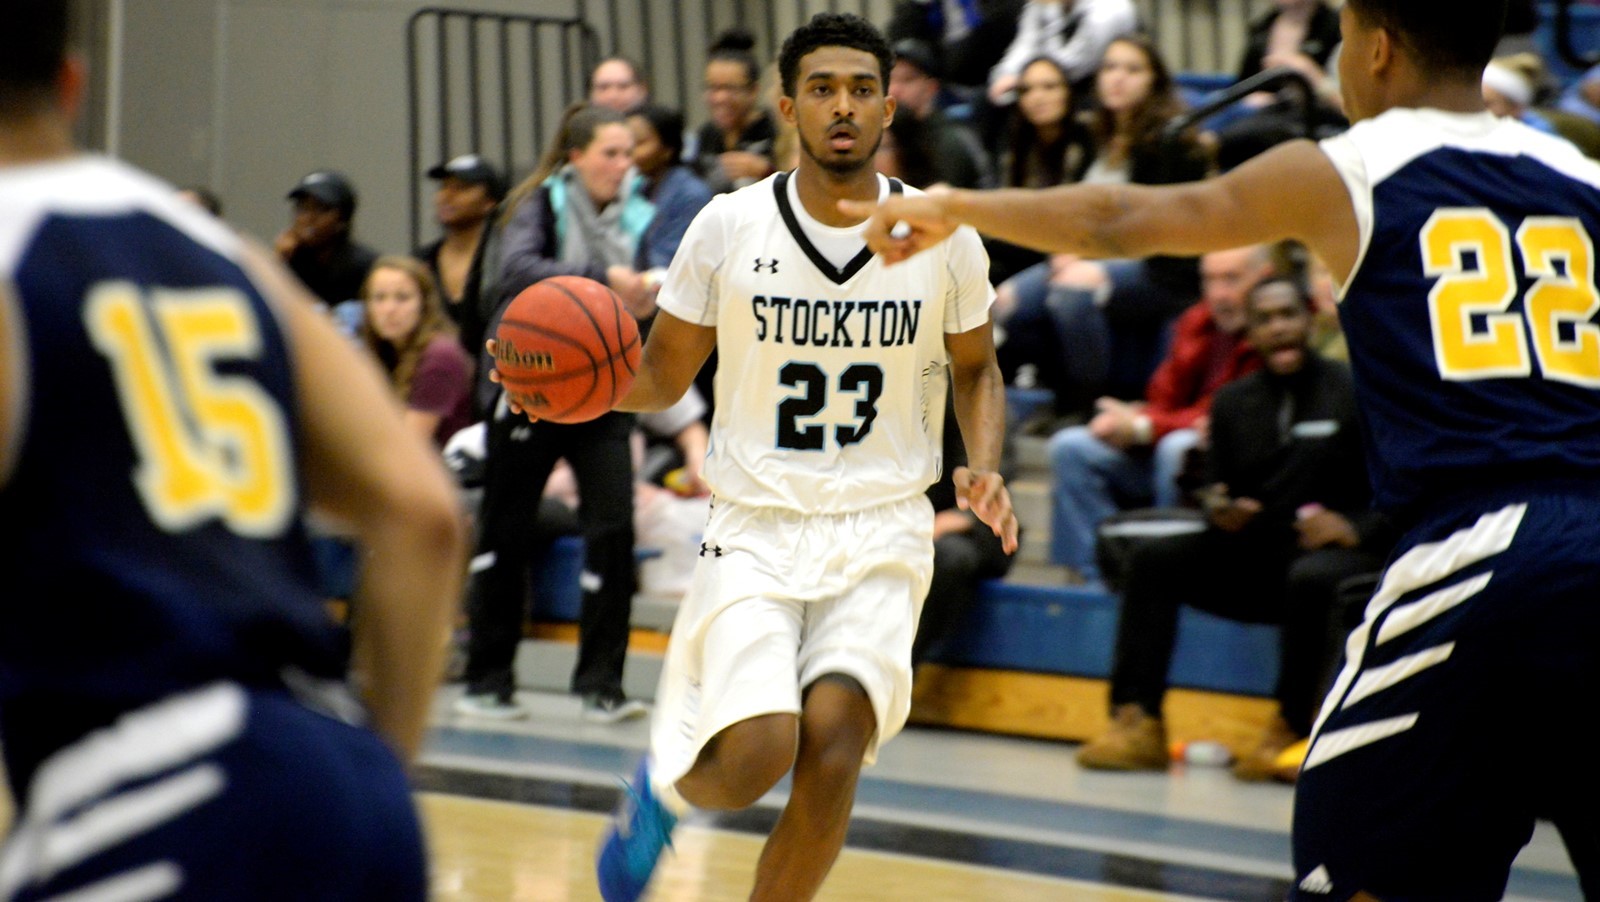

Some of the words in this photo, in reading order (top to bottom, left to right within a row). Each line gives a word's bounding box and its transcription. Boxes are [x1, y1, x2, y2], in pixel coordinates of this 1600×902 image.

[752, 295, 922, 347] STOCKTON
[1419, 207, 1600, 389] 22
[496, 338, 555, 373] ilson
[83, 281, 298, 538] 15
[775, 359, 885, 452] 23
